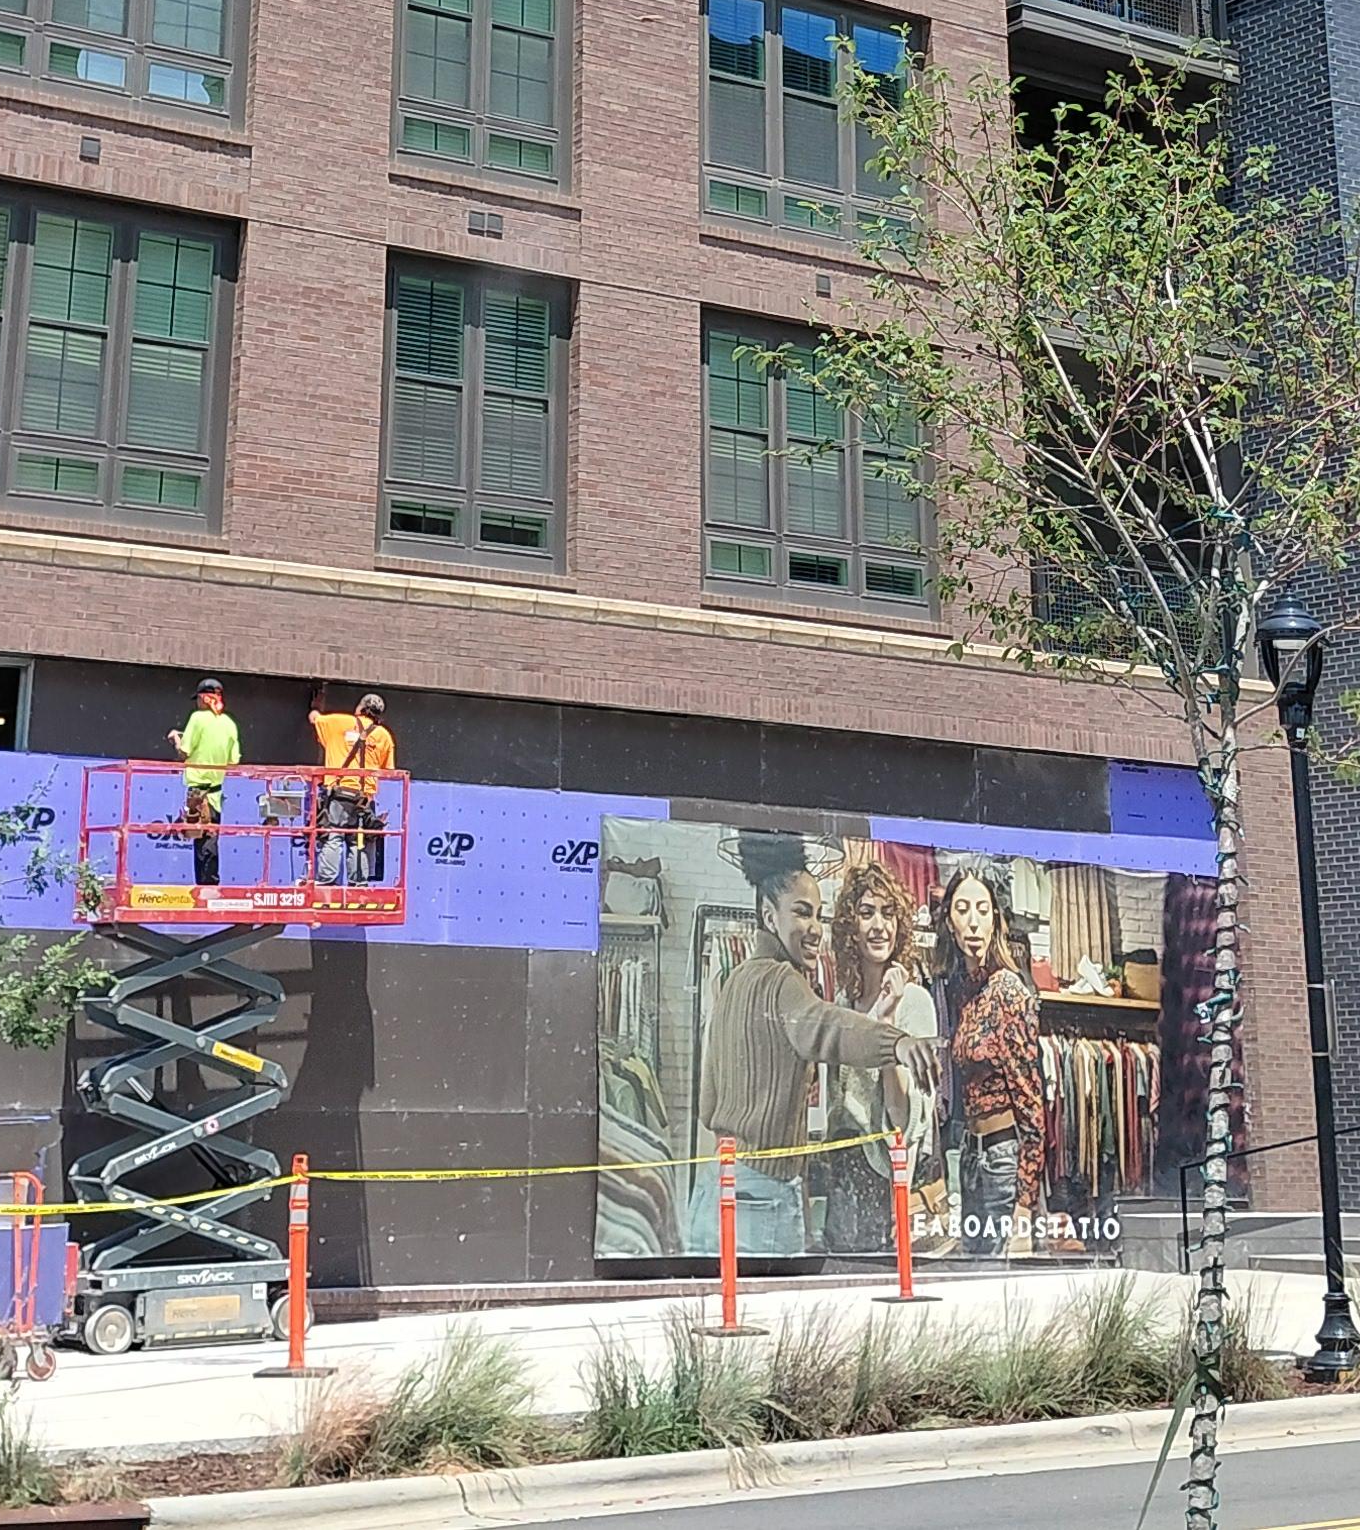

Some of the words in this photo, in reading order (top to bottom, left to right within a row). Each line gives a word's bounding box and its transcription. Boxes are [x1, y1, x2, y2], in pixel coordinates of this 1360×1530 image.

[427, 831, 475, 858] eXP
[551, 839, 599, 866] eXP
[279, 892, 306, 907] 3219
[912, 1213, 1121, 1241] EABOARDSTATIO
[176, 1269, 235, 1285] SKYJACK
